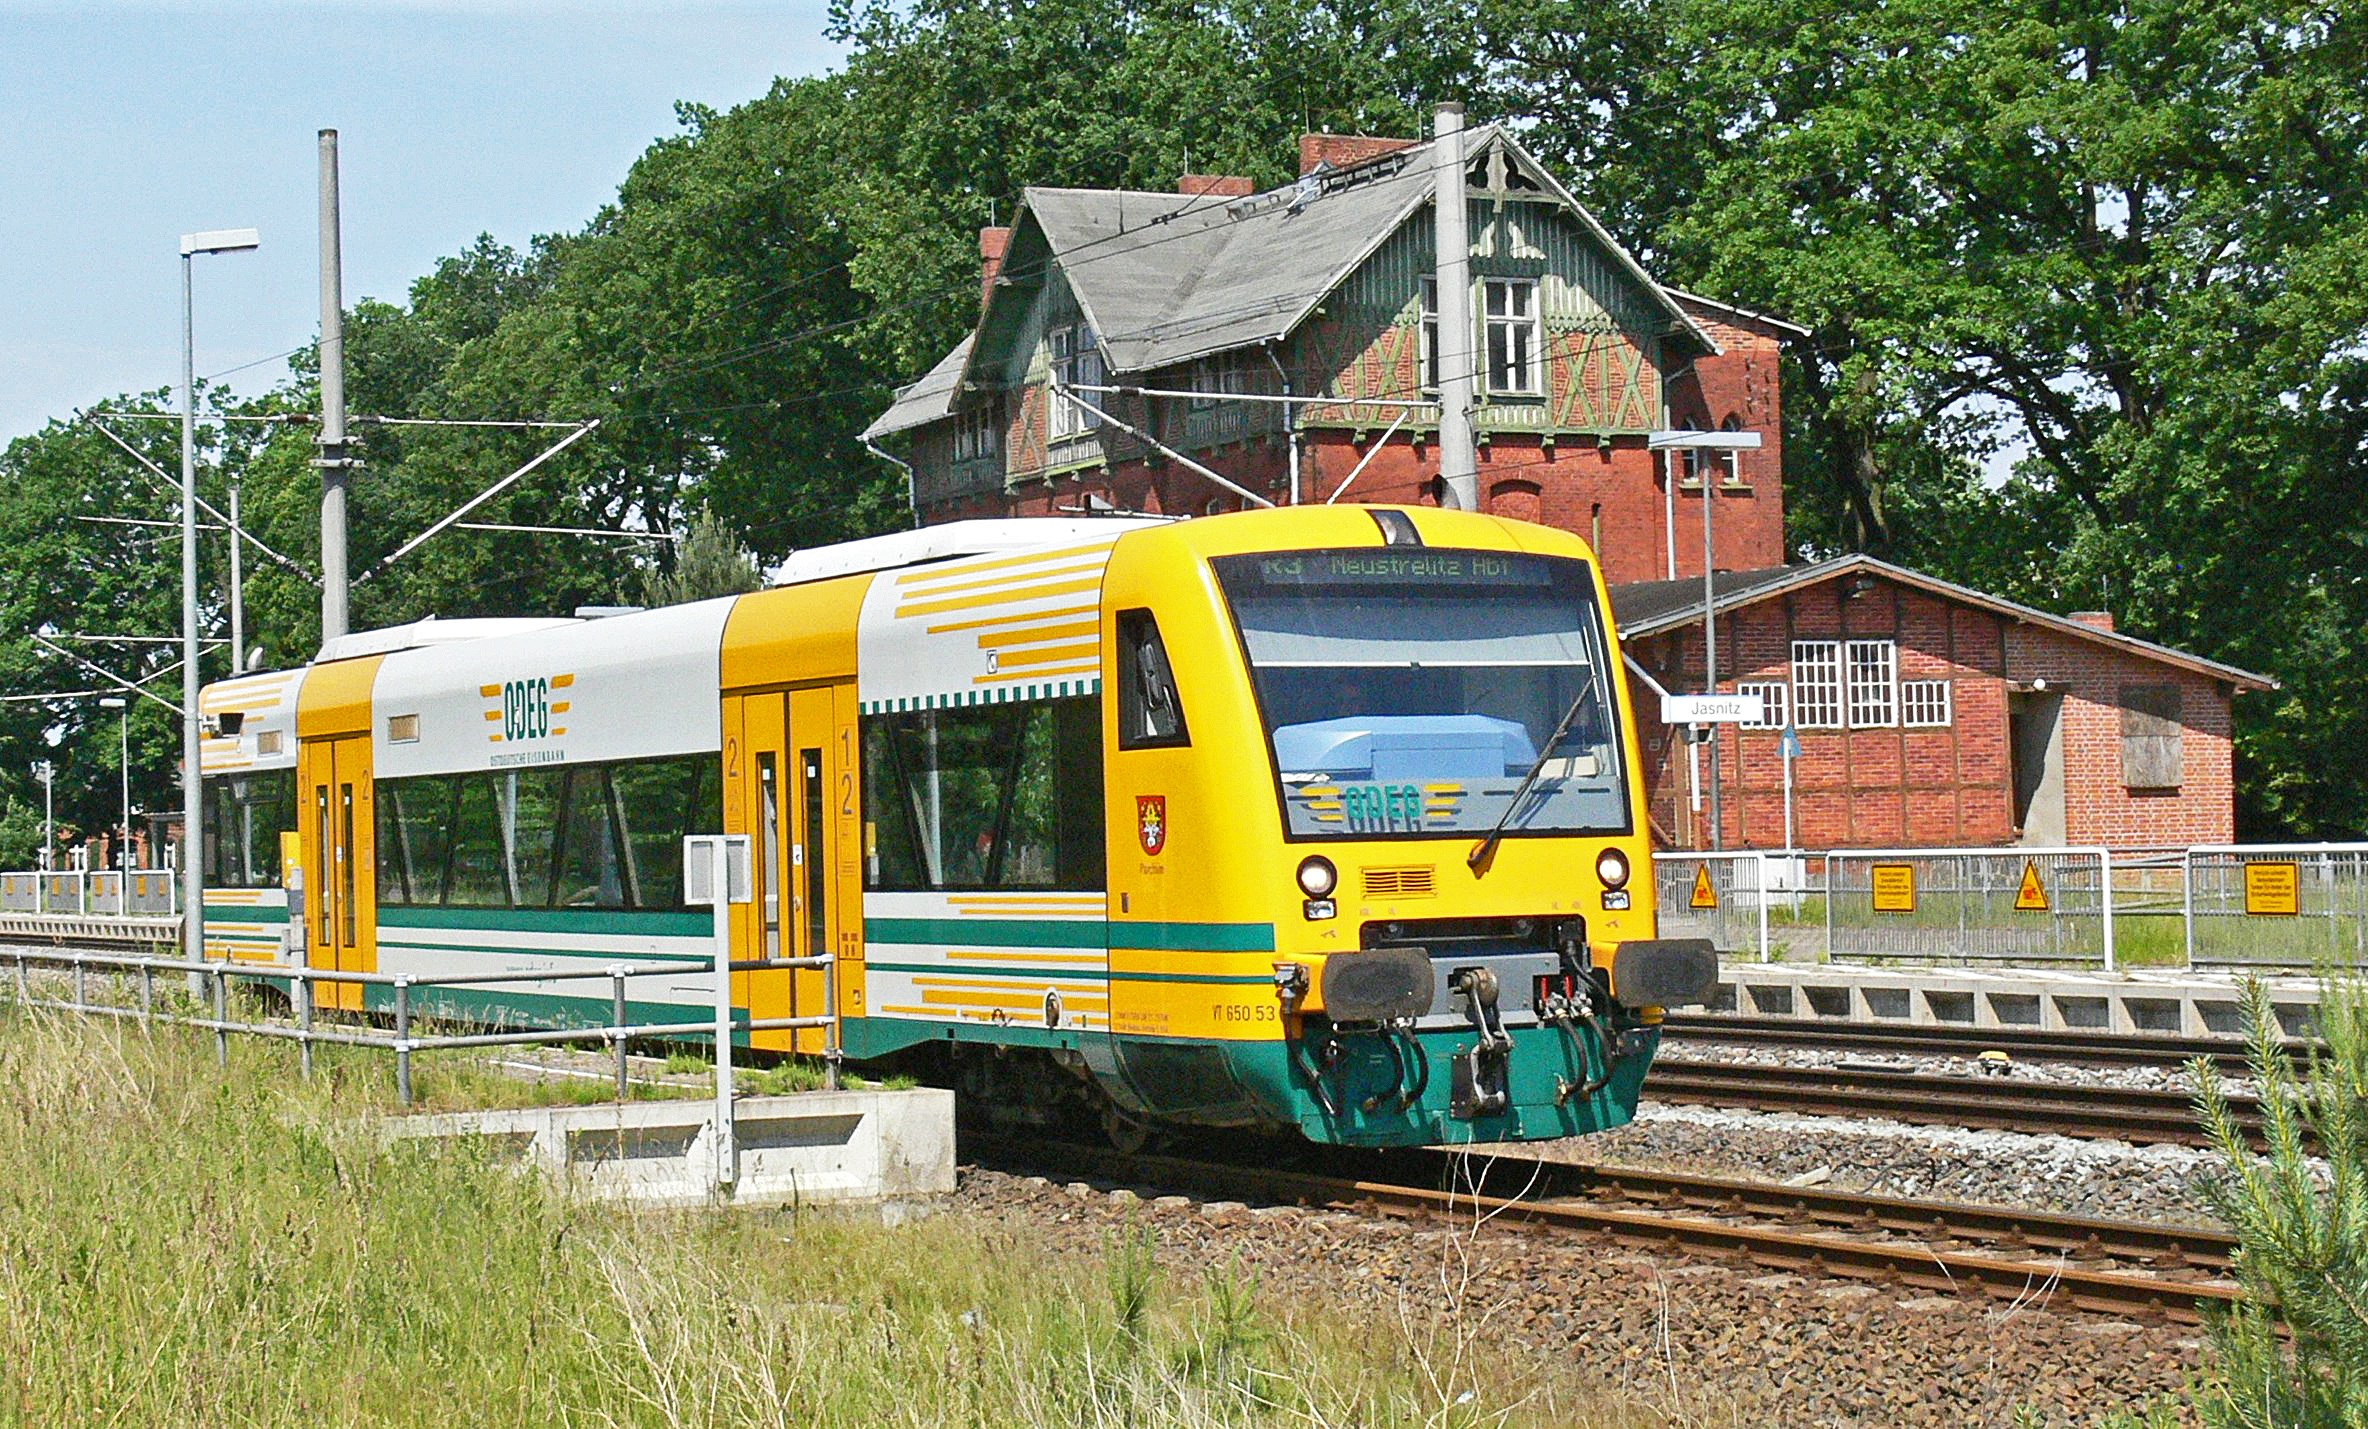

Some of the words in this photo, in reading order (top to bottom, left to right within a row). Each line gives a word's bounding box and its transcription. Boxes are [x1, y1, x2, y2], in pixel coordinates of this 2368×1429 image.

[1331, 556, 1461, 576] Neustrelitz
[505, 677, 548, 741] ODEG
[1691, 701, 1742, 715] Jasnitz
[728, 737, 738, 777] 2
[841, 774, 854, 815] 2
[1346, 784, 1421, 820] ODEG
